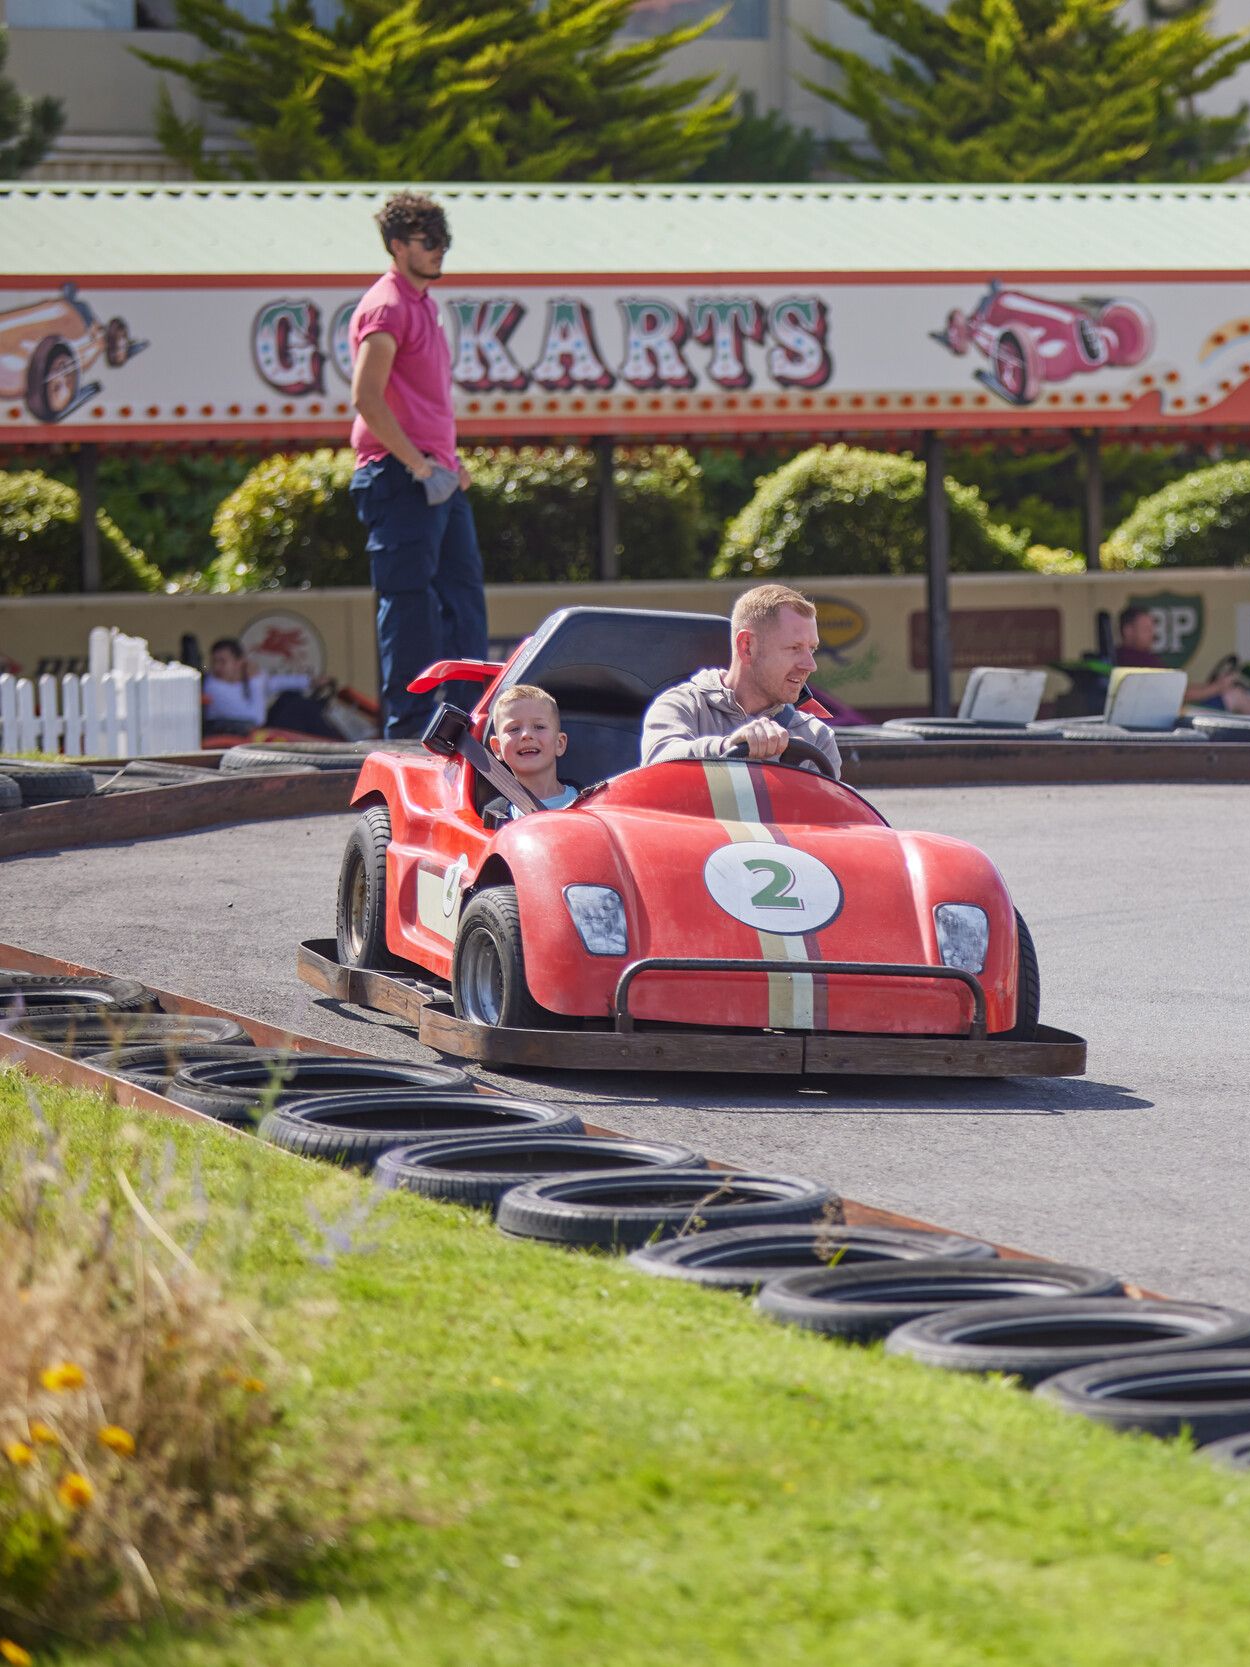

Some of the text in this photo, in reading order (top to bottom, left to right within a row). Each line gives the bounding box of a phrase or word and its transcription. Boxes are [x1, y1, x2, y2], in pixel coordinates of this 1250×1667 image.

[253, 297, 833, 396] G KARTS
[743, 858, 804, 911] 2
